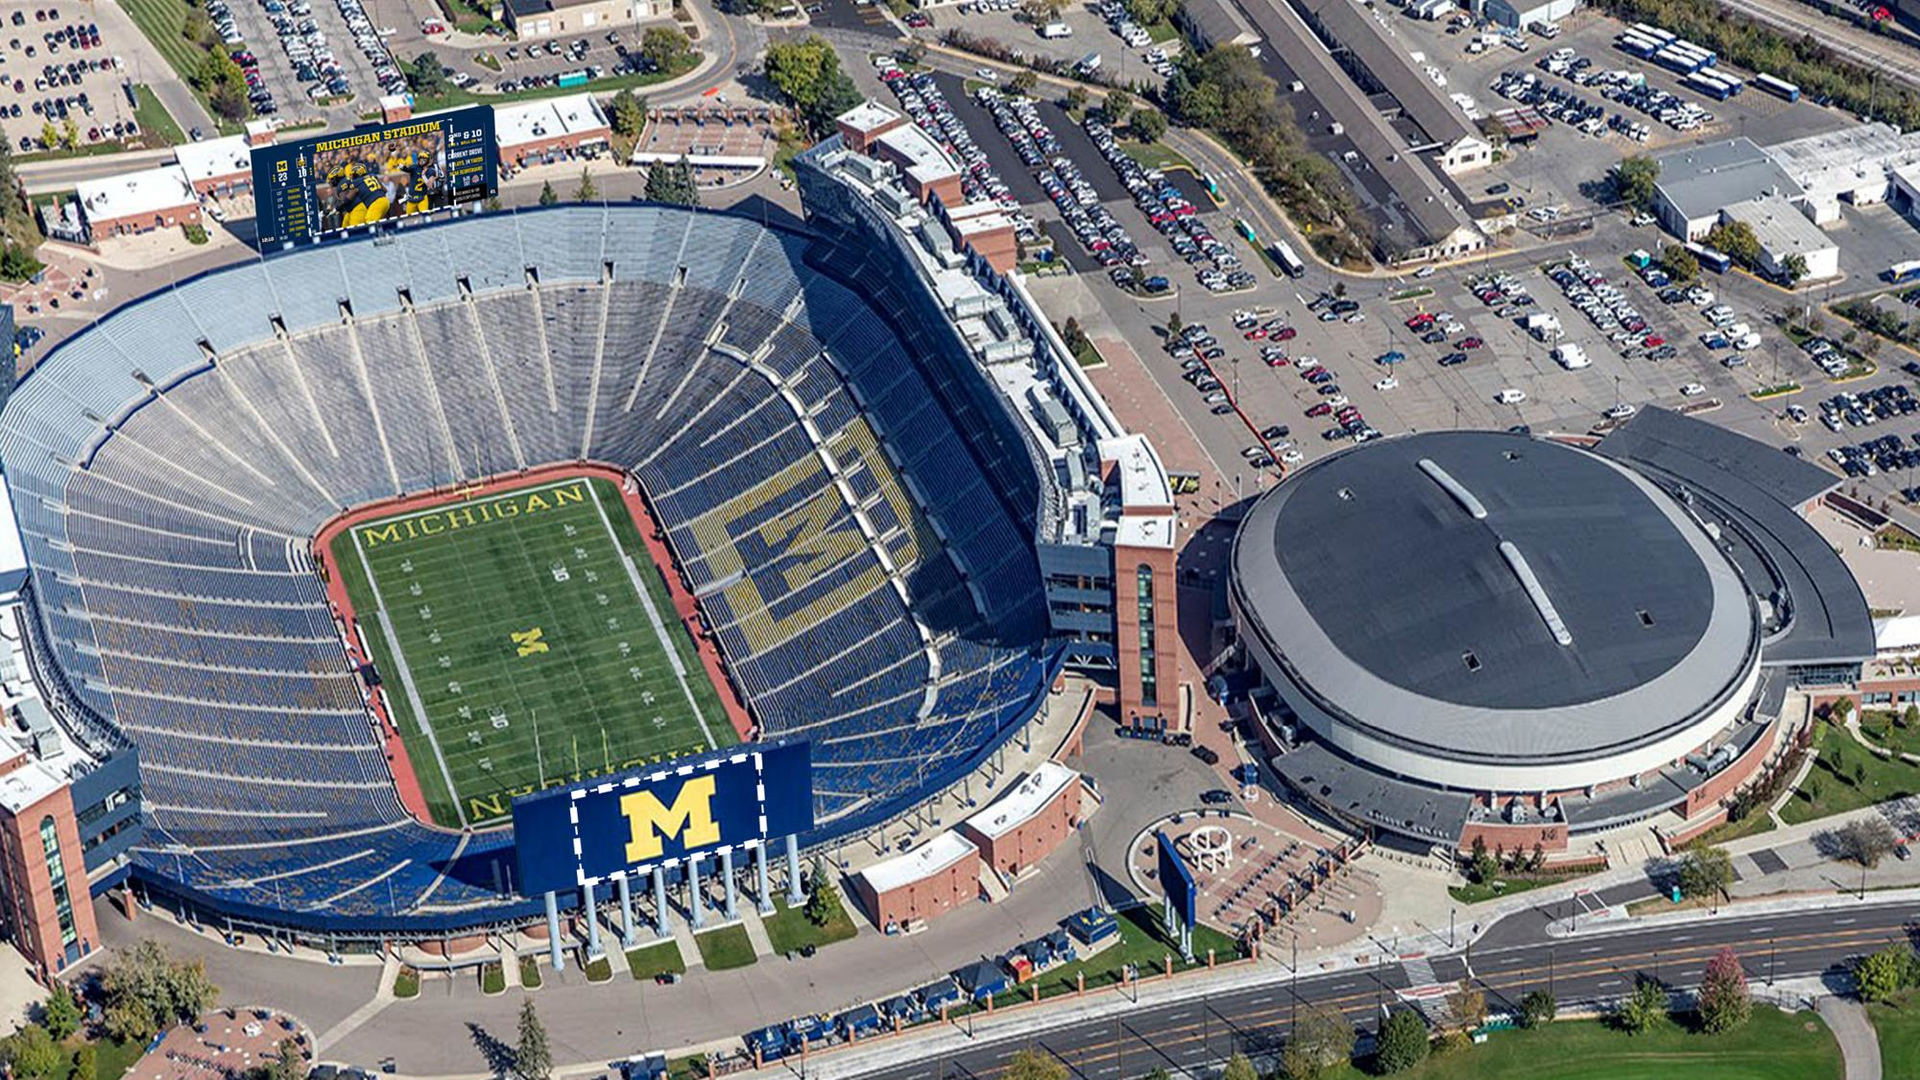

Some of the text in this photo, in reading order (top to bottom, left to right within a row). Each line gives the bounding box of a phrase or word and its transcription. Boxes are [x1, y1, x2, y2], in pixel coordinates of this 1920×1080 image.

[316, 121, 441, 152] MICHIGAN STADIUM
[471, 129, 482, 138] 10
[278, 172, 288, 182] 23
[414, 178, 424, 191] 2
[363, 484, 584, 547] MICHIGAN
[510, 626, 549, 657] M
[619, 774, 721, 864] M
